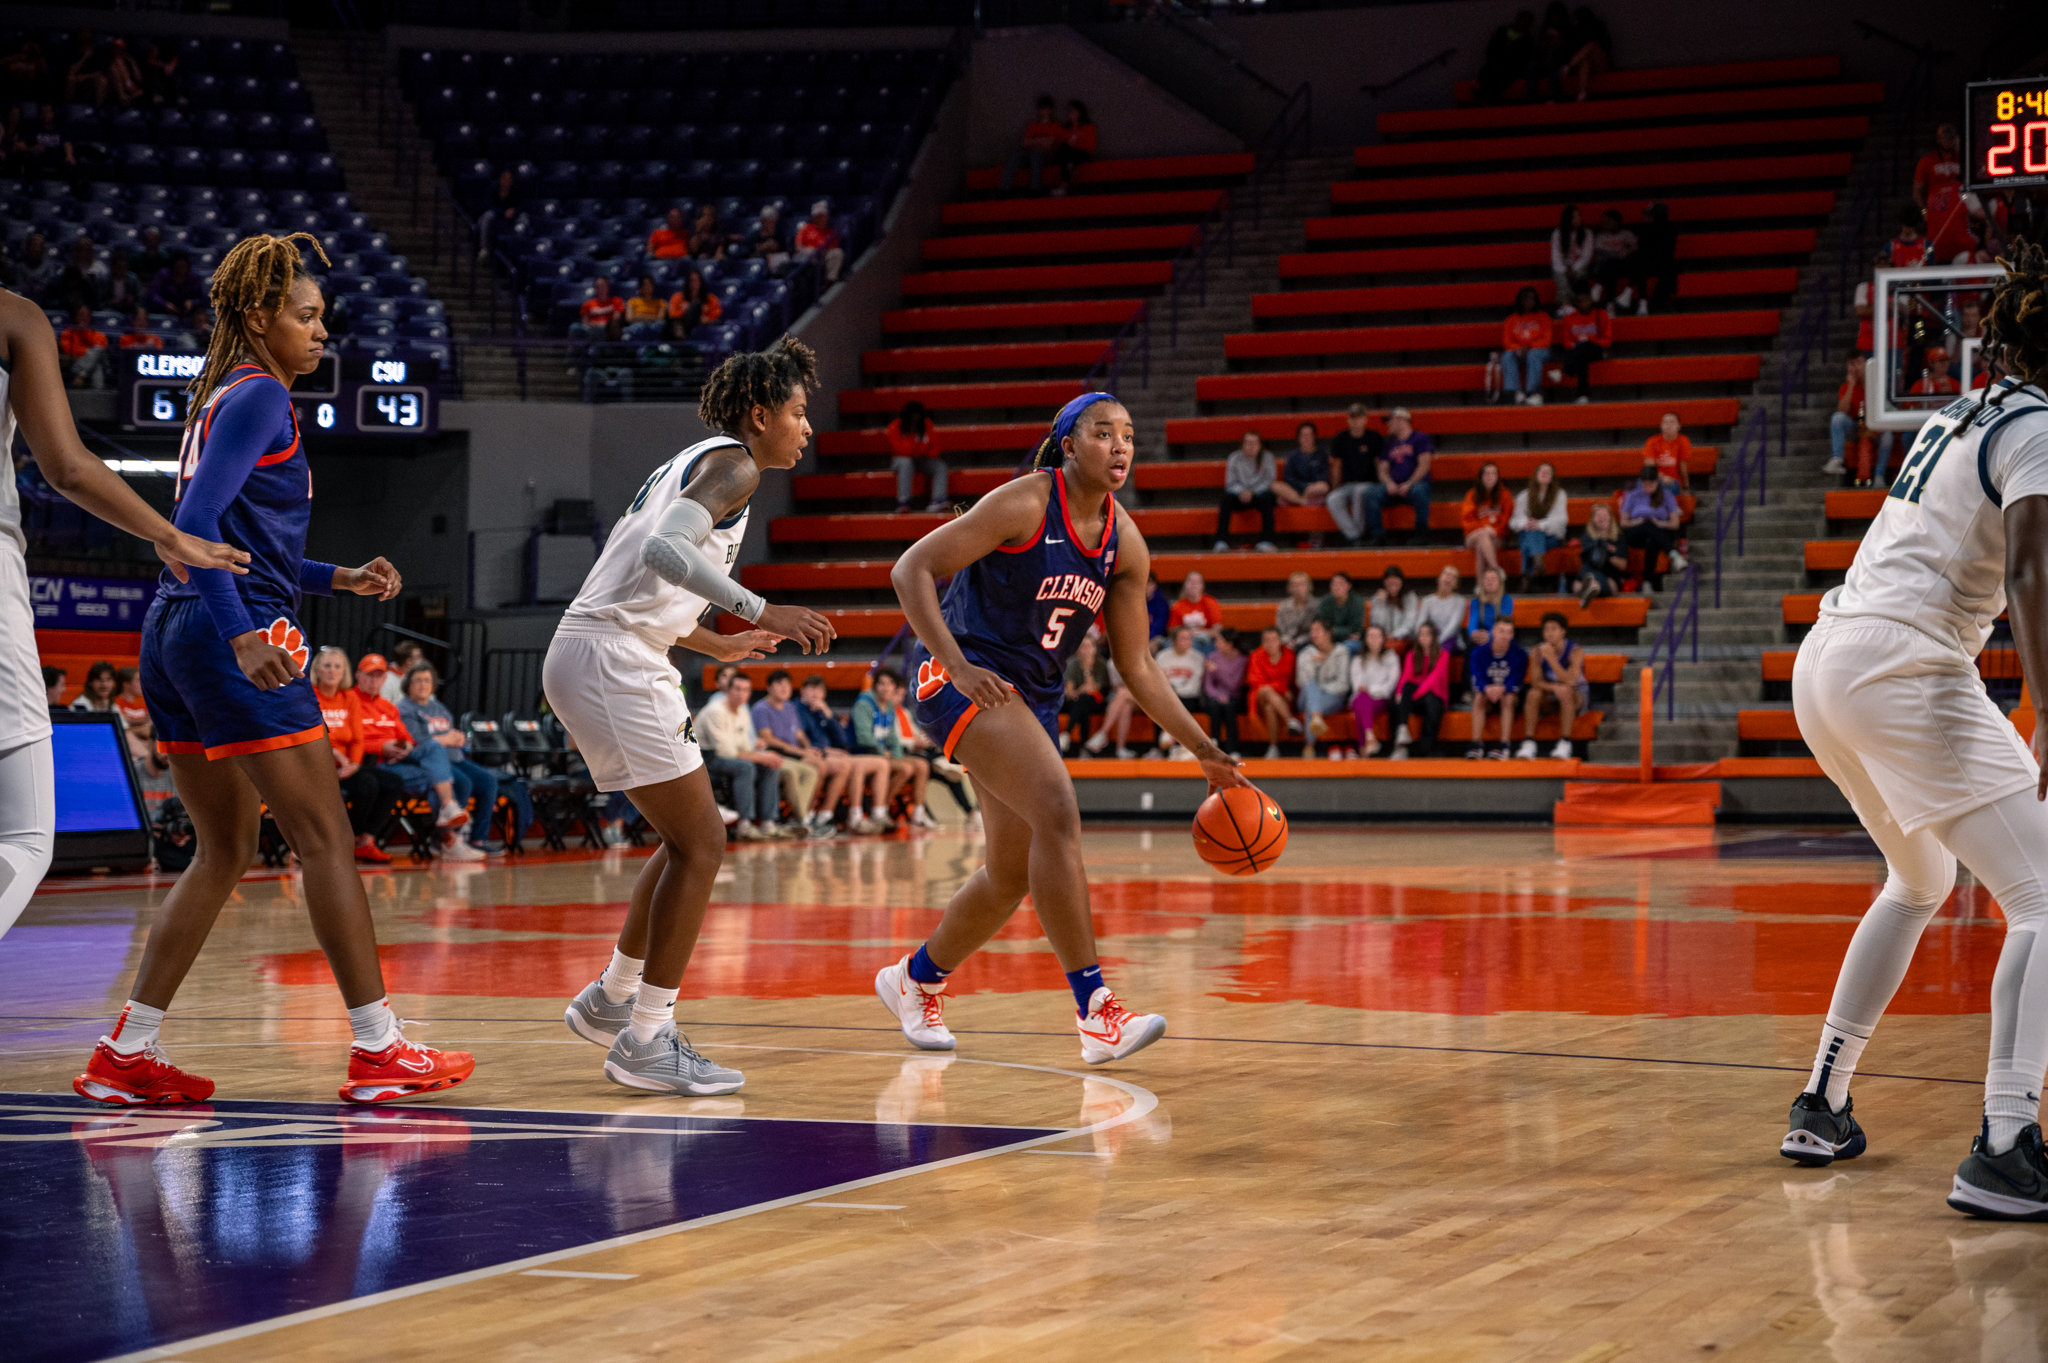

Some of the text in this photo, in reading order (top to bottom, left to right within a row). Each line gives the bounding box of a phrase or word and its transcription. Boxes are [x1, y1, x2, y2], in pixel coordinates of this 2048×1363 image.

[1996, 89, 2048, 120] 8:4
[1987, 121, 2048, 176] 20
[137, 354, 210, 378] CLEMSO
[371, 361, 407, 383] CSU
[377, 393, 419, 426] 43
[1887, 423, 1956, 507] 21
[1041, 606, 1077, 650] 5
